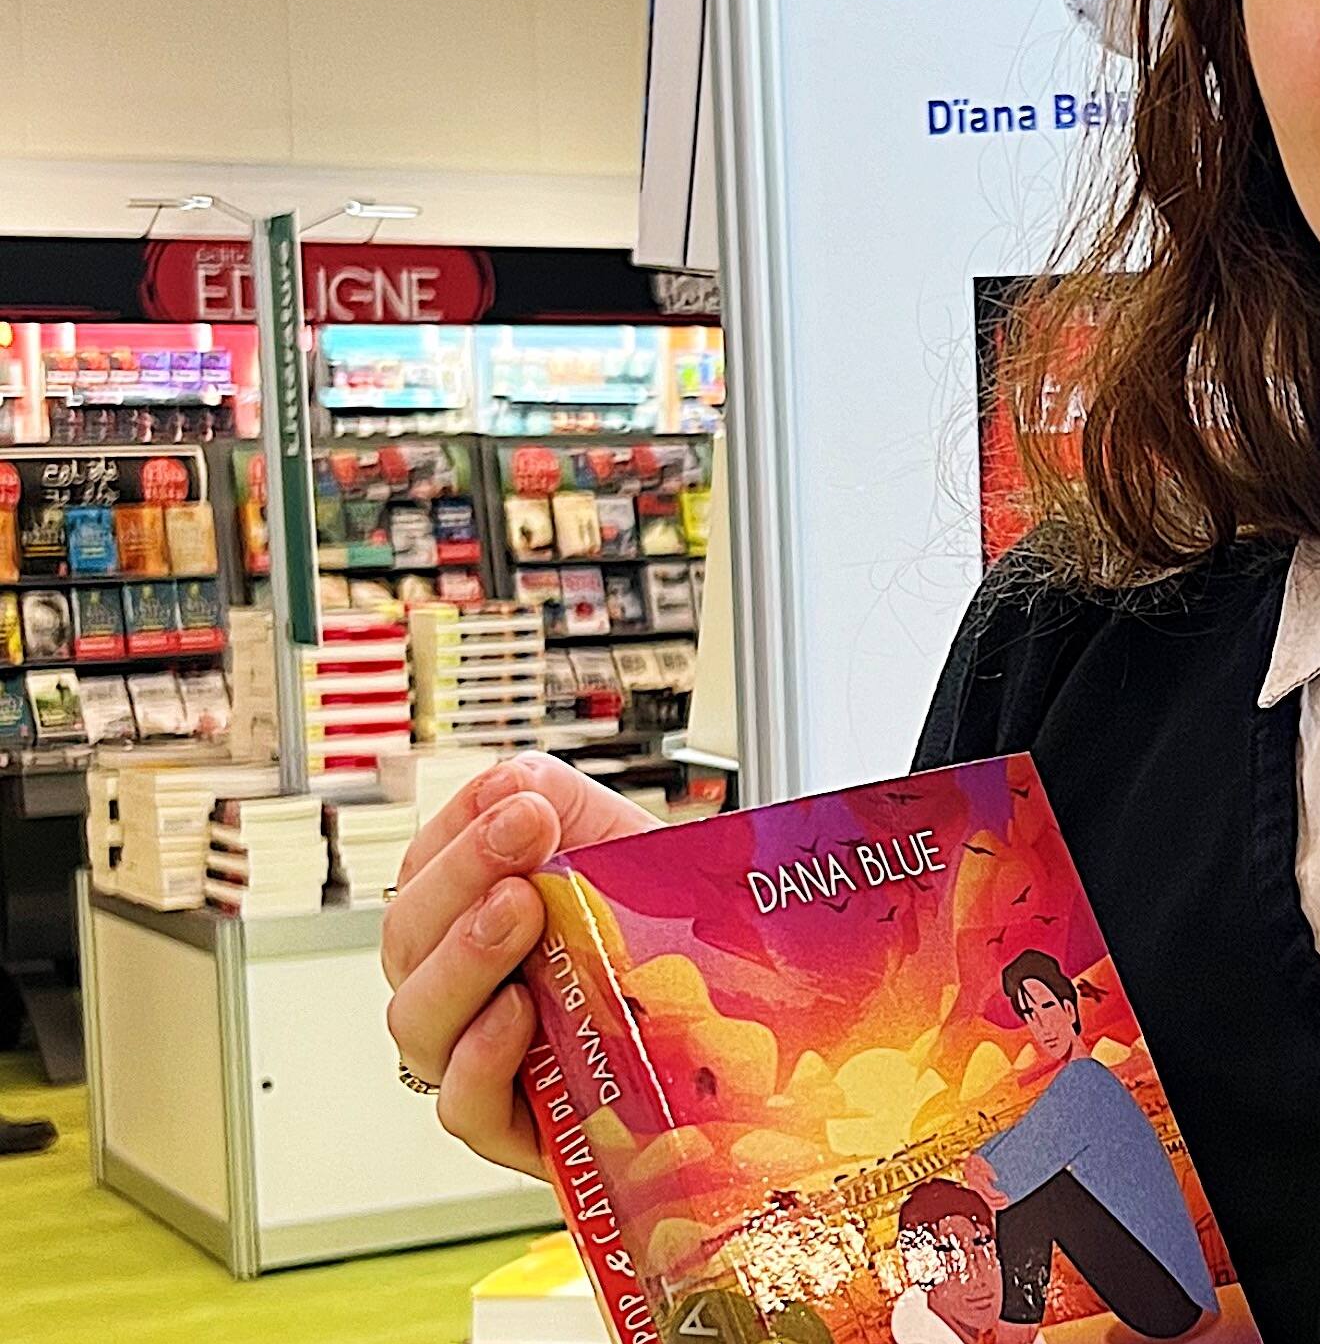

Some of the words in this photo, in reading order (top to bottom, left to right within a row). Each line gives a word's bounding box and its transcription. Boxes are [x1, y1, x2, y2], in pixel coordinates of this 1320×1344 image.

[927, 99, 1037, 136] Dïana
[746, 853, 851, 915] DANA
[858, 830, 946, 888] BLUE
[543, 935, 587, 1013] BLUE
[574, 1016, 621, 1107] DANA
